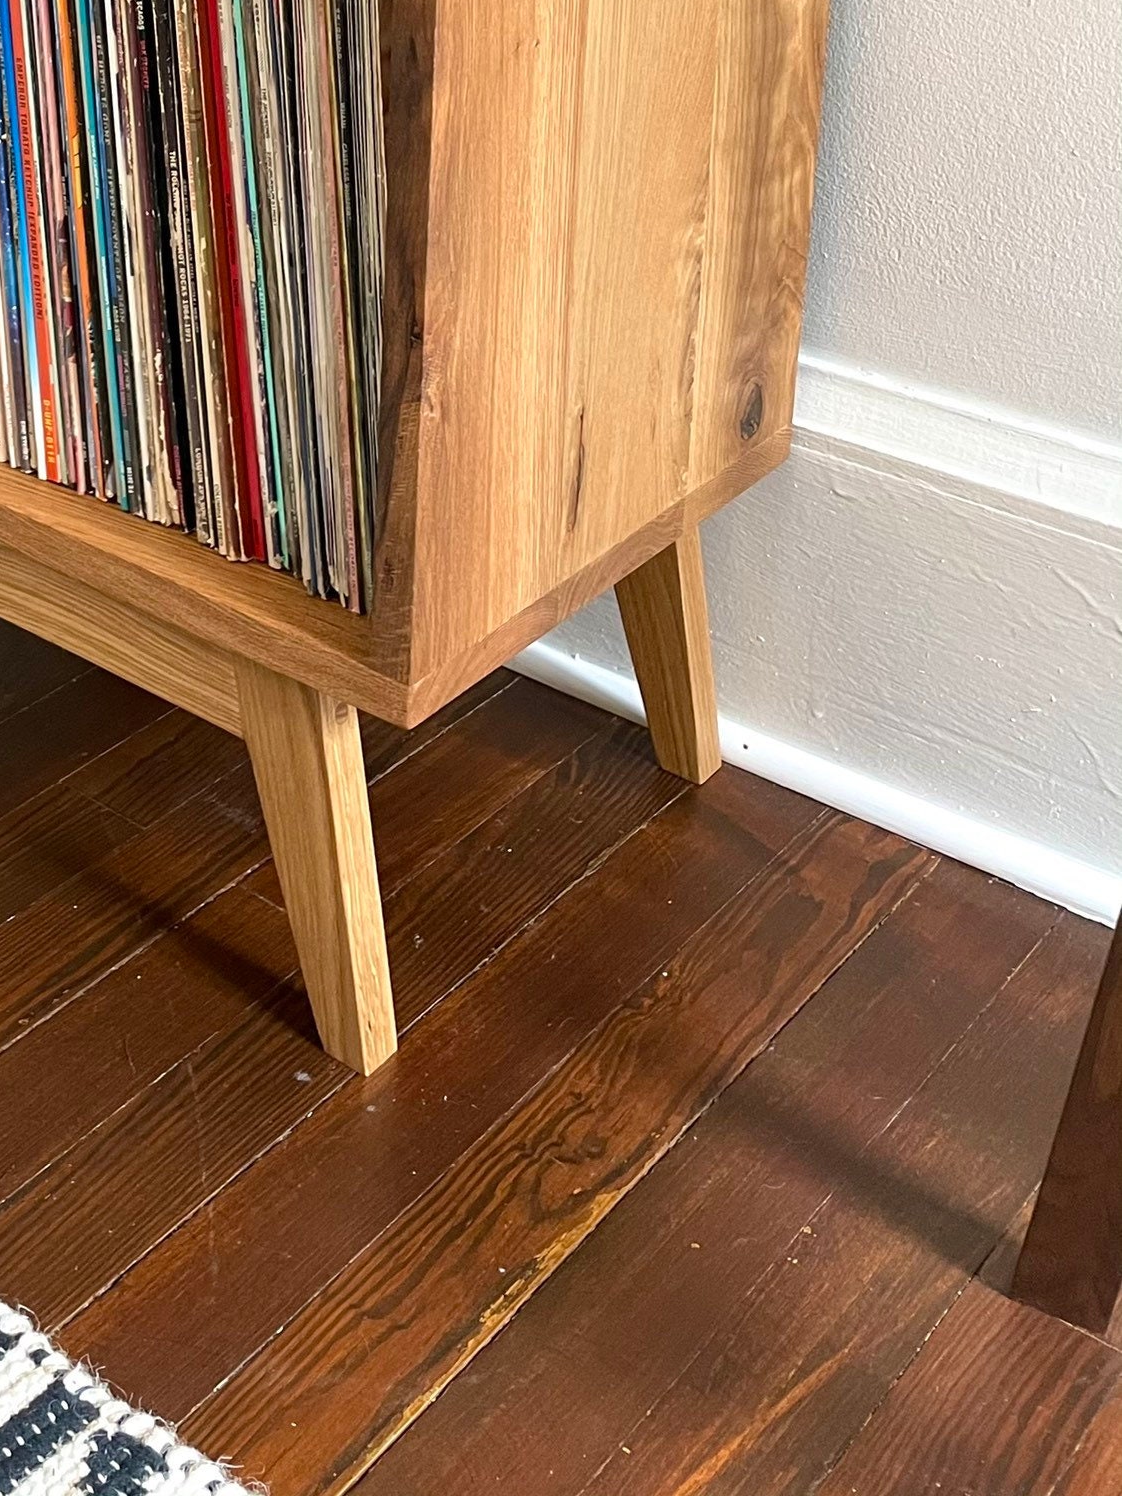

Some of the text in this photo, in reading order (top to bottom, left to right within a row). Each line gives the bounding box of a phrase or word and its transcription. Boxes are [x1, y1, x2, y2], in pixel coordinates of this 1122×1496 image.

[136, 1, 144, 31] SCAGGS
[103, 113, 111, 146] GONE
[168, 150, 176, 168] THE
[16, 57, 43, 320] EMPEROR TOMATO KETCHUP (EXPANDED EDITION)
[179, 268, 188, 298] ROCKS
[181, 299, 192, 344] 1964-1971
[195, 447, 205, 483] LONDON
